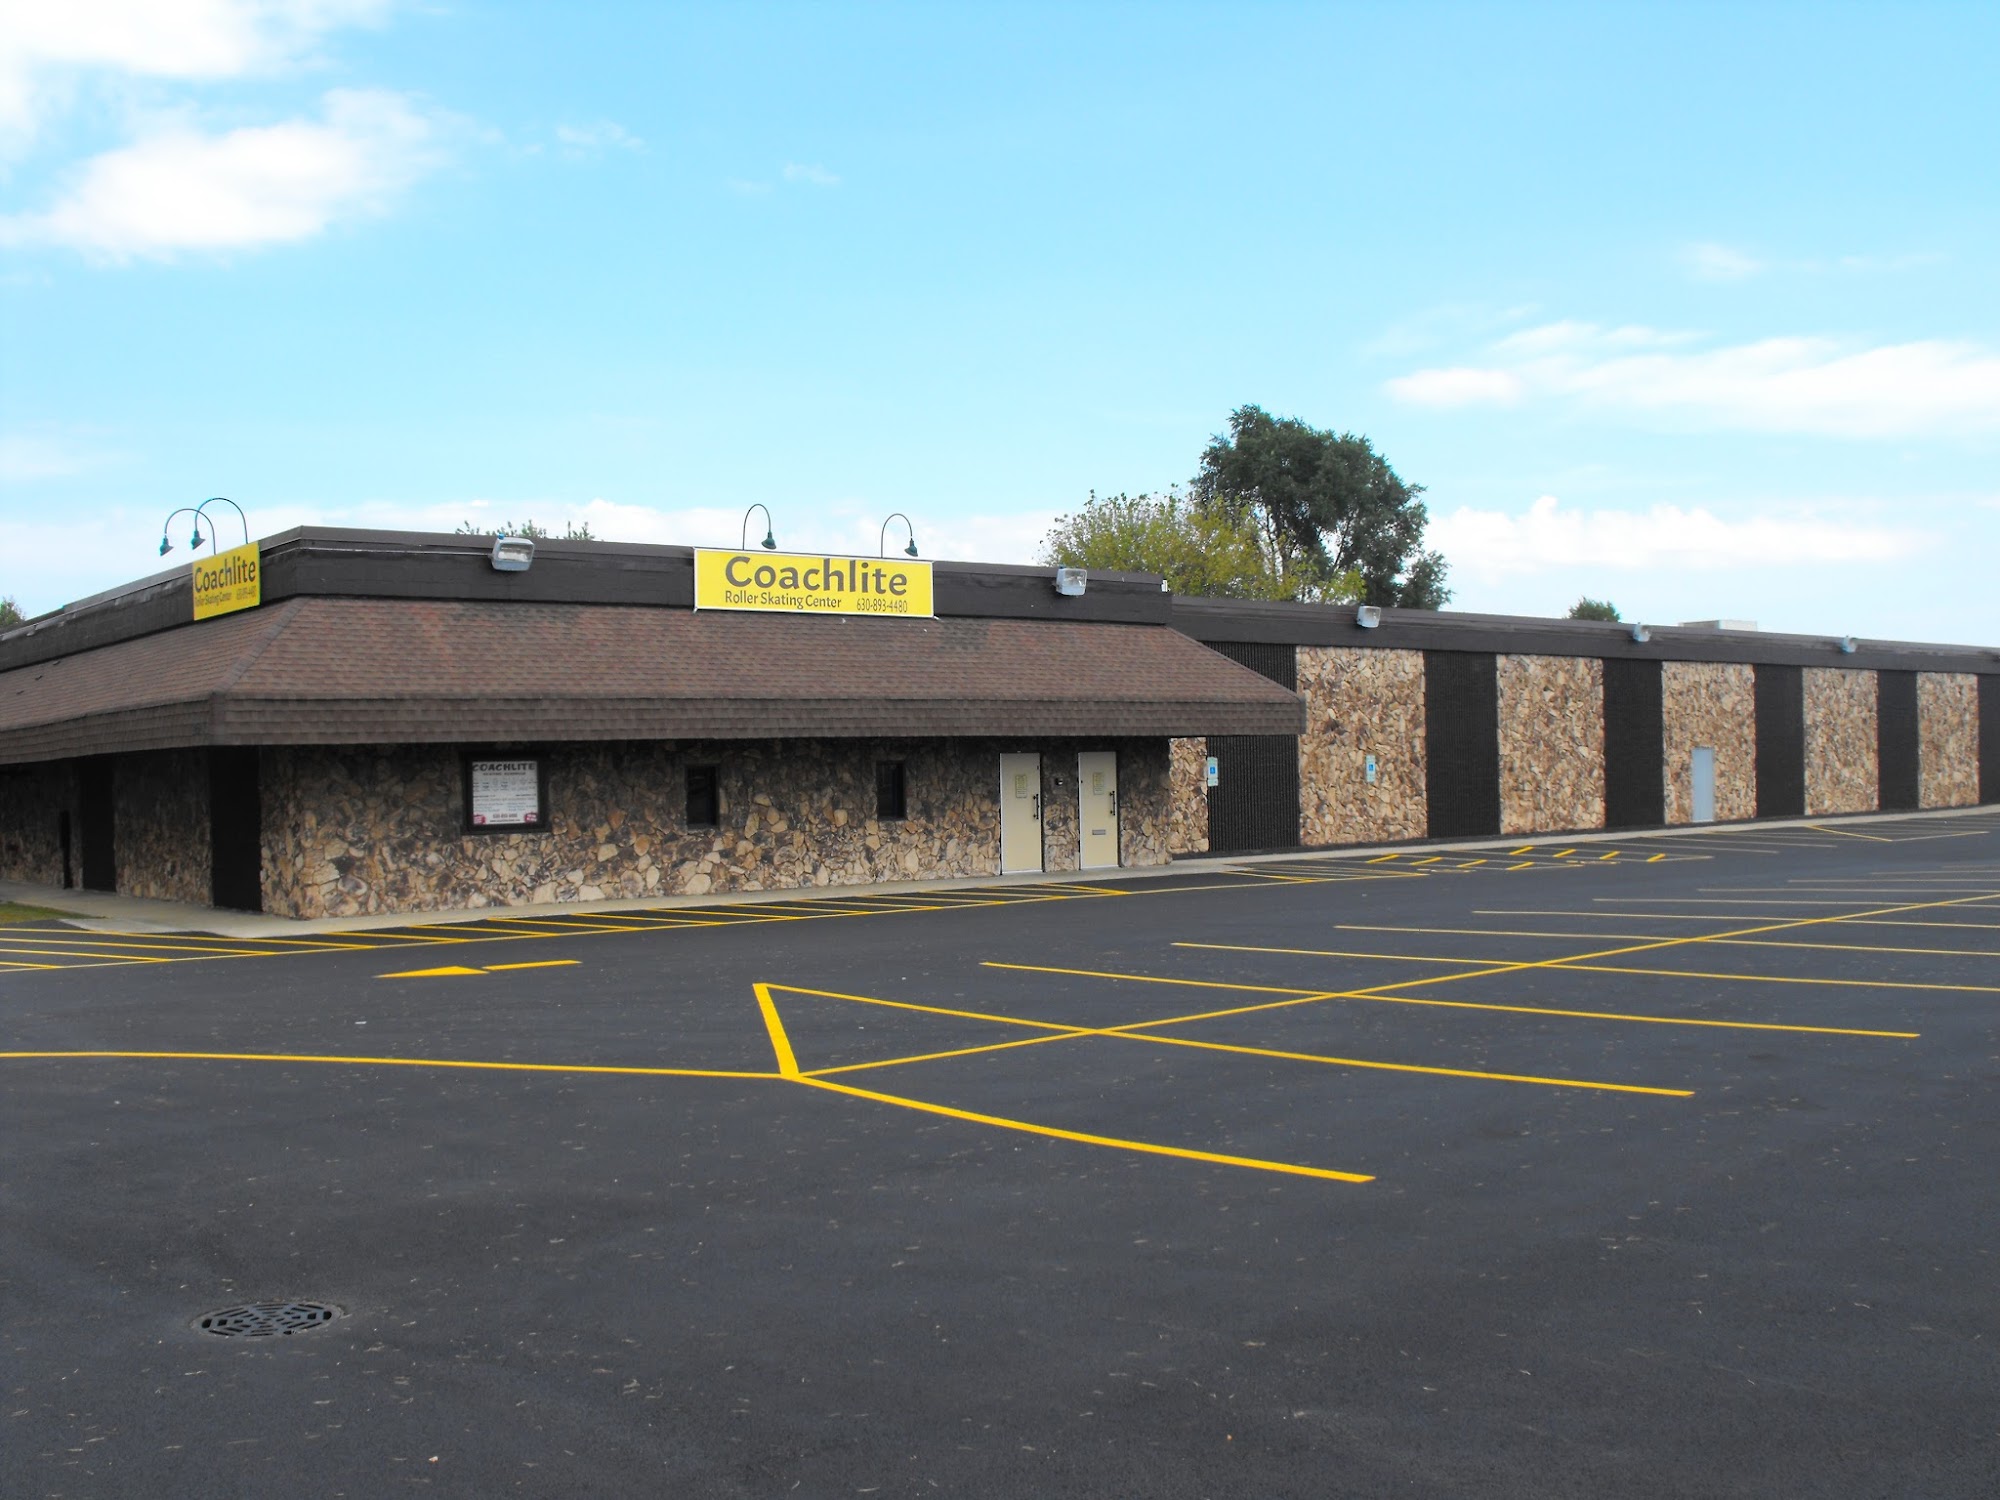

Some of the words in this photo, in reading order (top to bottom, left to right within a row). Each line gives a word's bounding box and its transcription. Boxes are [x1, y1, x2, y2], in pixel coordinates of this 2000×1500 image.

[195, 556, 256, 593] Coachlite
[725, 556, 908, 596] Coachlite
[725, 590, 758, 604] Roller
[760, 592, 804, 610] Skating
[805, 594, 842, 608] Center
[856, 597, 908, 613] 630-893-4480
[472, 763, 536, 771] COACHLITE
